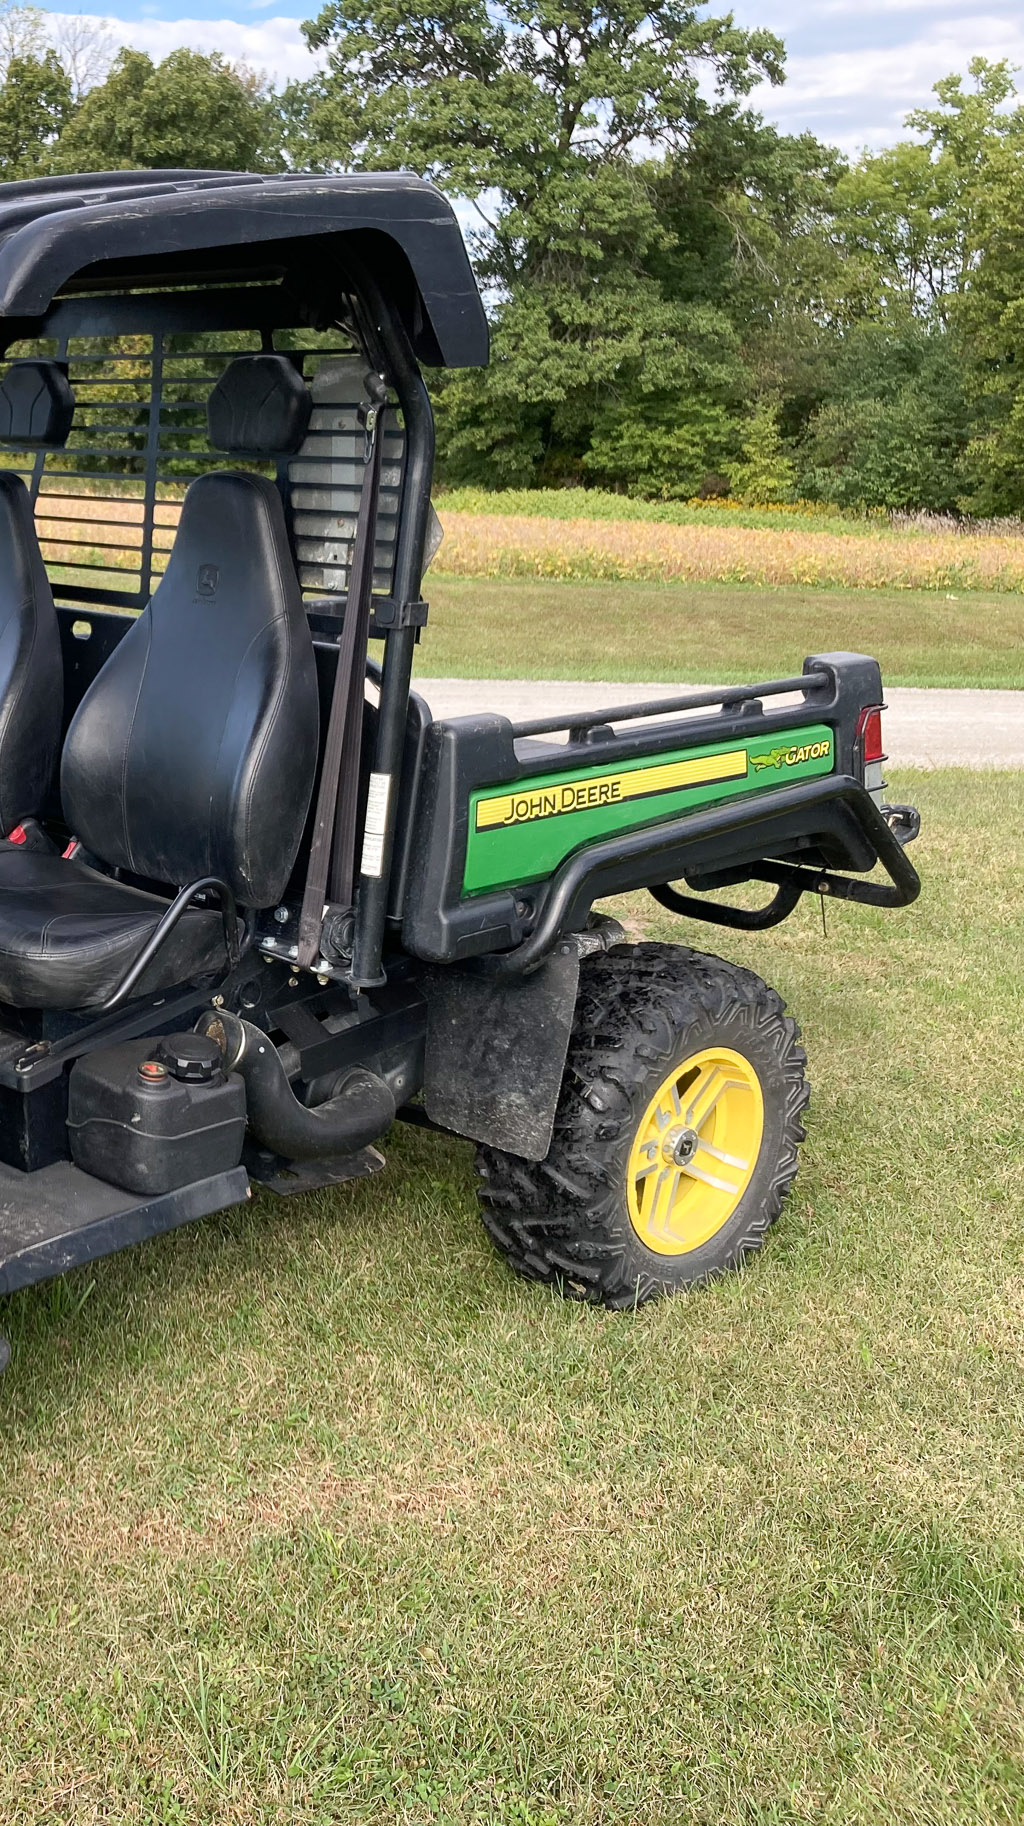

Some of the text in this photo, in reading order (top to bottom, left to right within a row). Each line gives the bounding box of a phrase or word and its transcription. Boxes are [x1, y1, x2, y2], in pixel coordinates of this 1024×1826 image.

[785, 740, 830, 766] GATOR
[504, 781, 621, 822] JOHN DEERE
